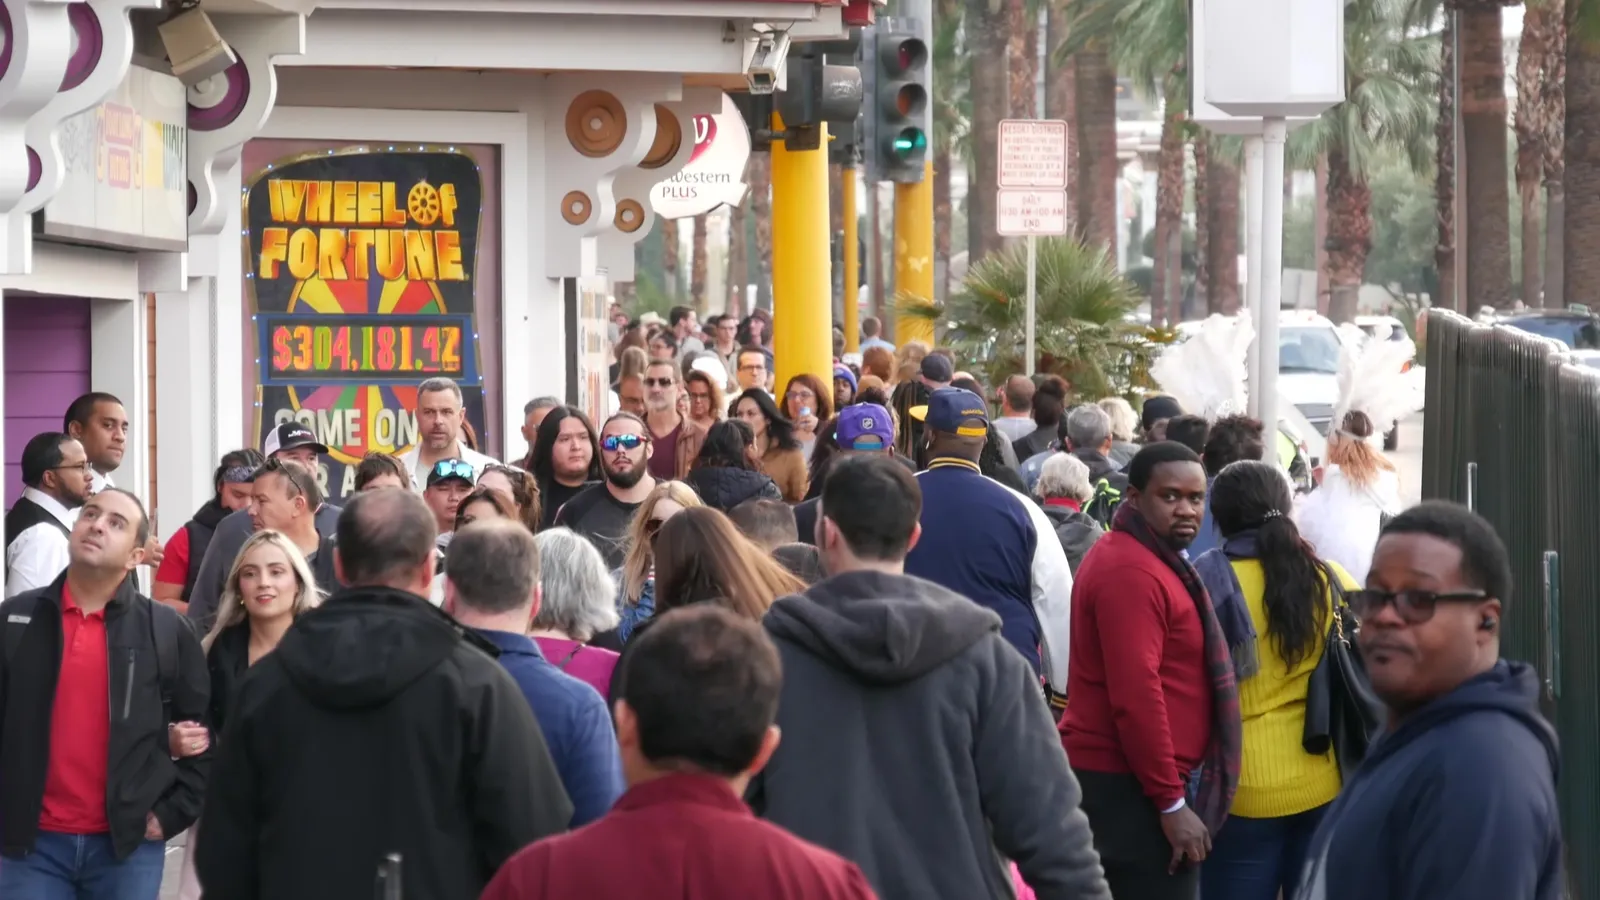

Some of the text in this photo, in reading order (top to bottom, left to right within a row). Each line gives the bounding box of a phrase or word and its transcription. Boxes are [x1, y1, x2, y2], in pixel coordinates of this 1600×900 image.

[268, 179, 406, 226] WHEEL
[662, 186, 698, 198] PLUS
[259, 227, 465, 281] FORTUNE
[272, 325, 461, 372] $304,181.42
